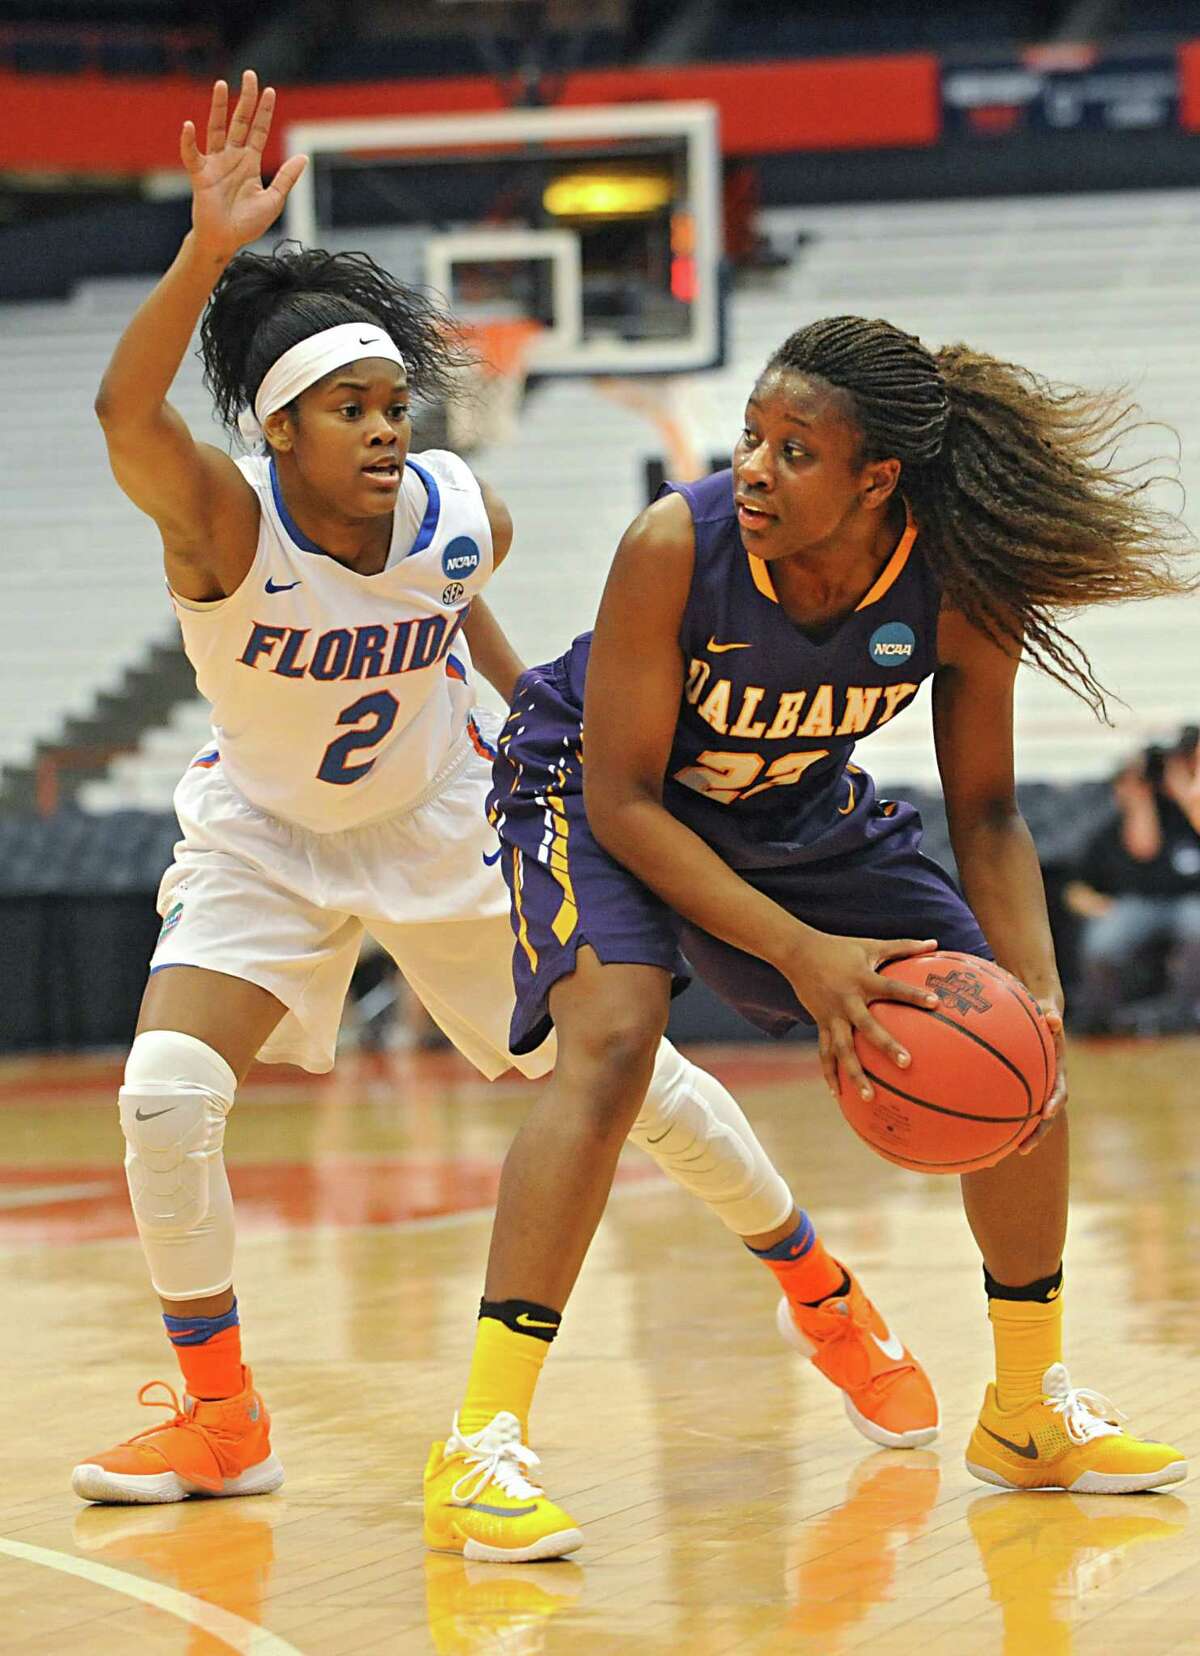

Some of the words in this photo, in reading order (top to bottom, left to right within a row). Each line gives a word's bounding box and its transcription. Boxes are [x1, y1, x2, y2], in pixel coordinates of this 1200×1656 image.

[446, 554, 478, 571] NCAA
[442, 582, 464, 605] SEC
[873, 642, 913, 657] NCAA
[316, 689, 400, 785] 2
